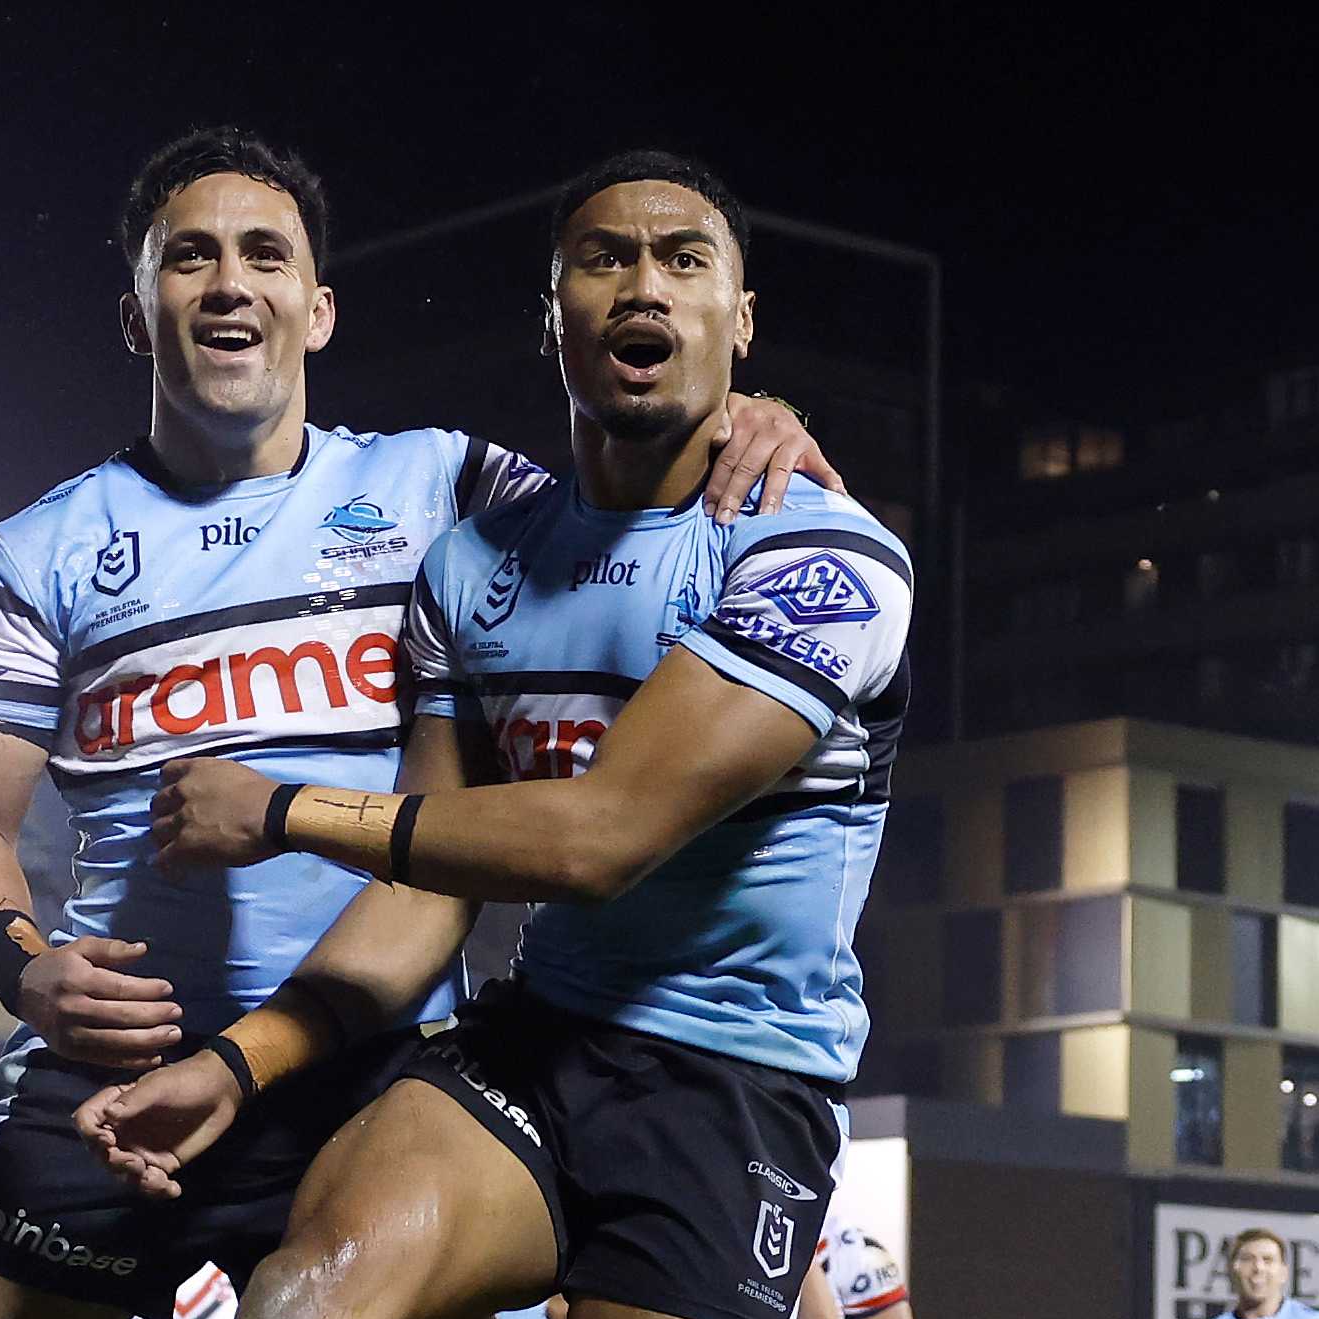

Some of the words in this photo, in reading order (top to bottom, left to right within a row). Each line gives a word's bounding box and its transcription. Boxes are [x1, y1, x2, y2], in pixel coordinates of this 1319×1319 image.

[568, 552, 641, 592] pilot
[89, 603, 150, 632] PREMIERSHIP
[747, 1160, 794, 1195] CLASSIC
[737, 1283, 787, 1313] PREMIERSHIP
